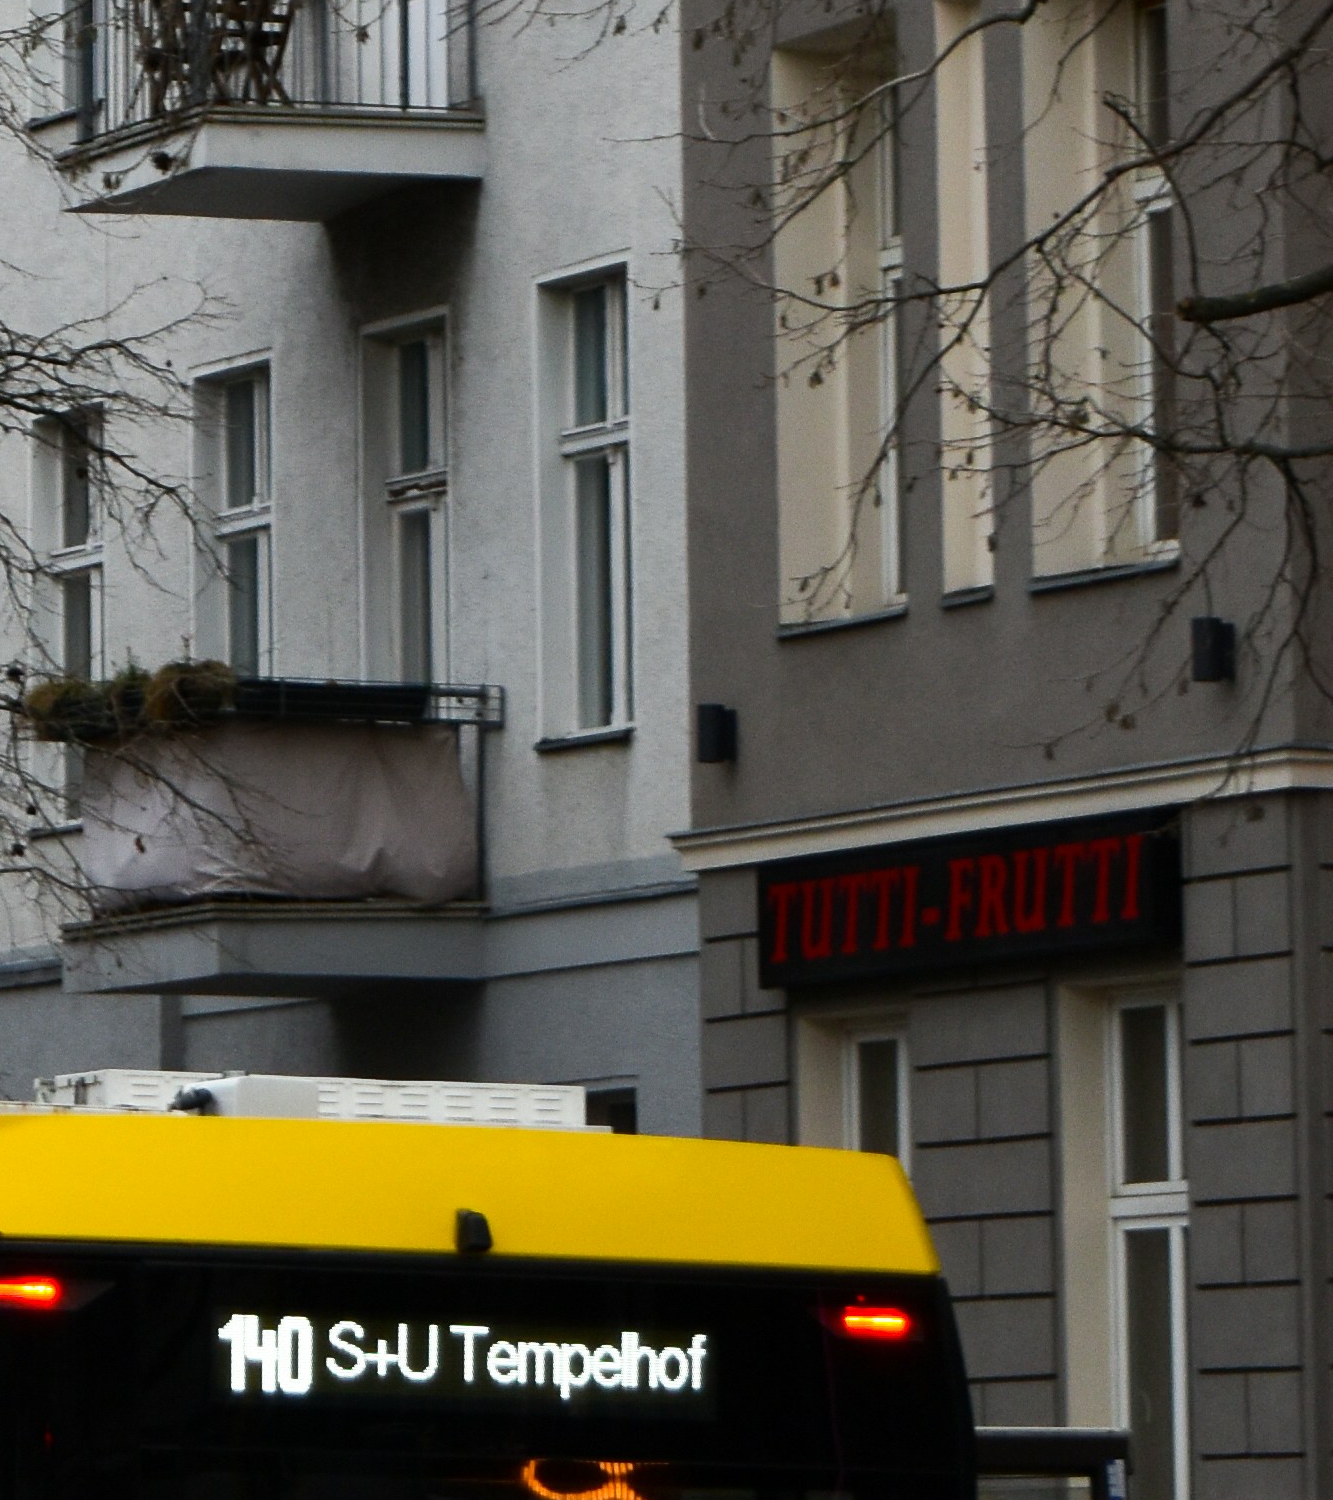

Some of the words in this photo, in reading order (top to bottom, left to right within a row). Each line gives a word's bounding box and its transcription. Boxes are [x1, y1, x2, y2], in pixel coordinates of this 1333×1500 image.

[766, 833, 1146, 965] TUTTI-FRUTTI
[218, 1313, 314, 1394] 140
[326, 1320, 440, 1381] S+U
[448, 1324, 708, 1401] Tempelhof
